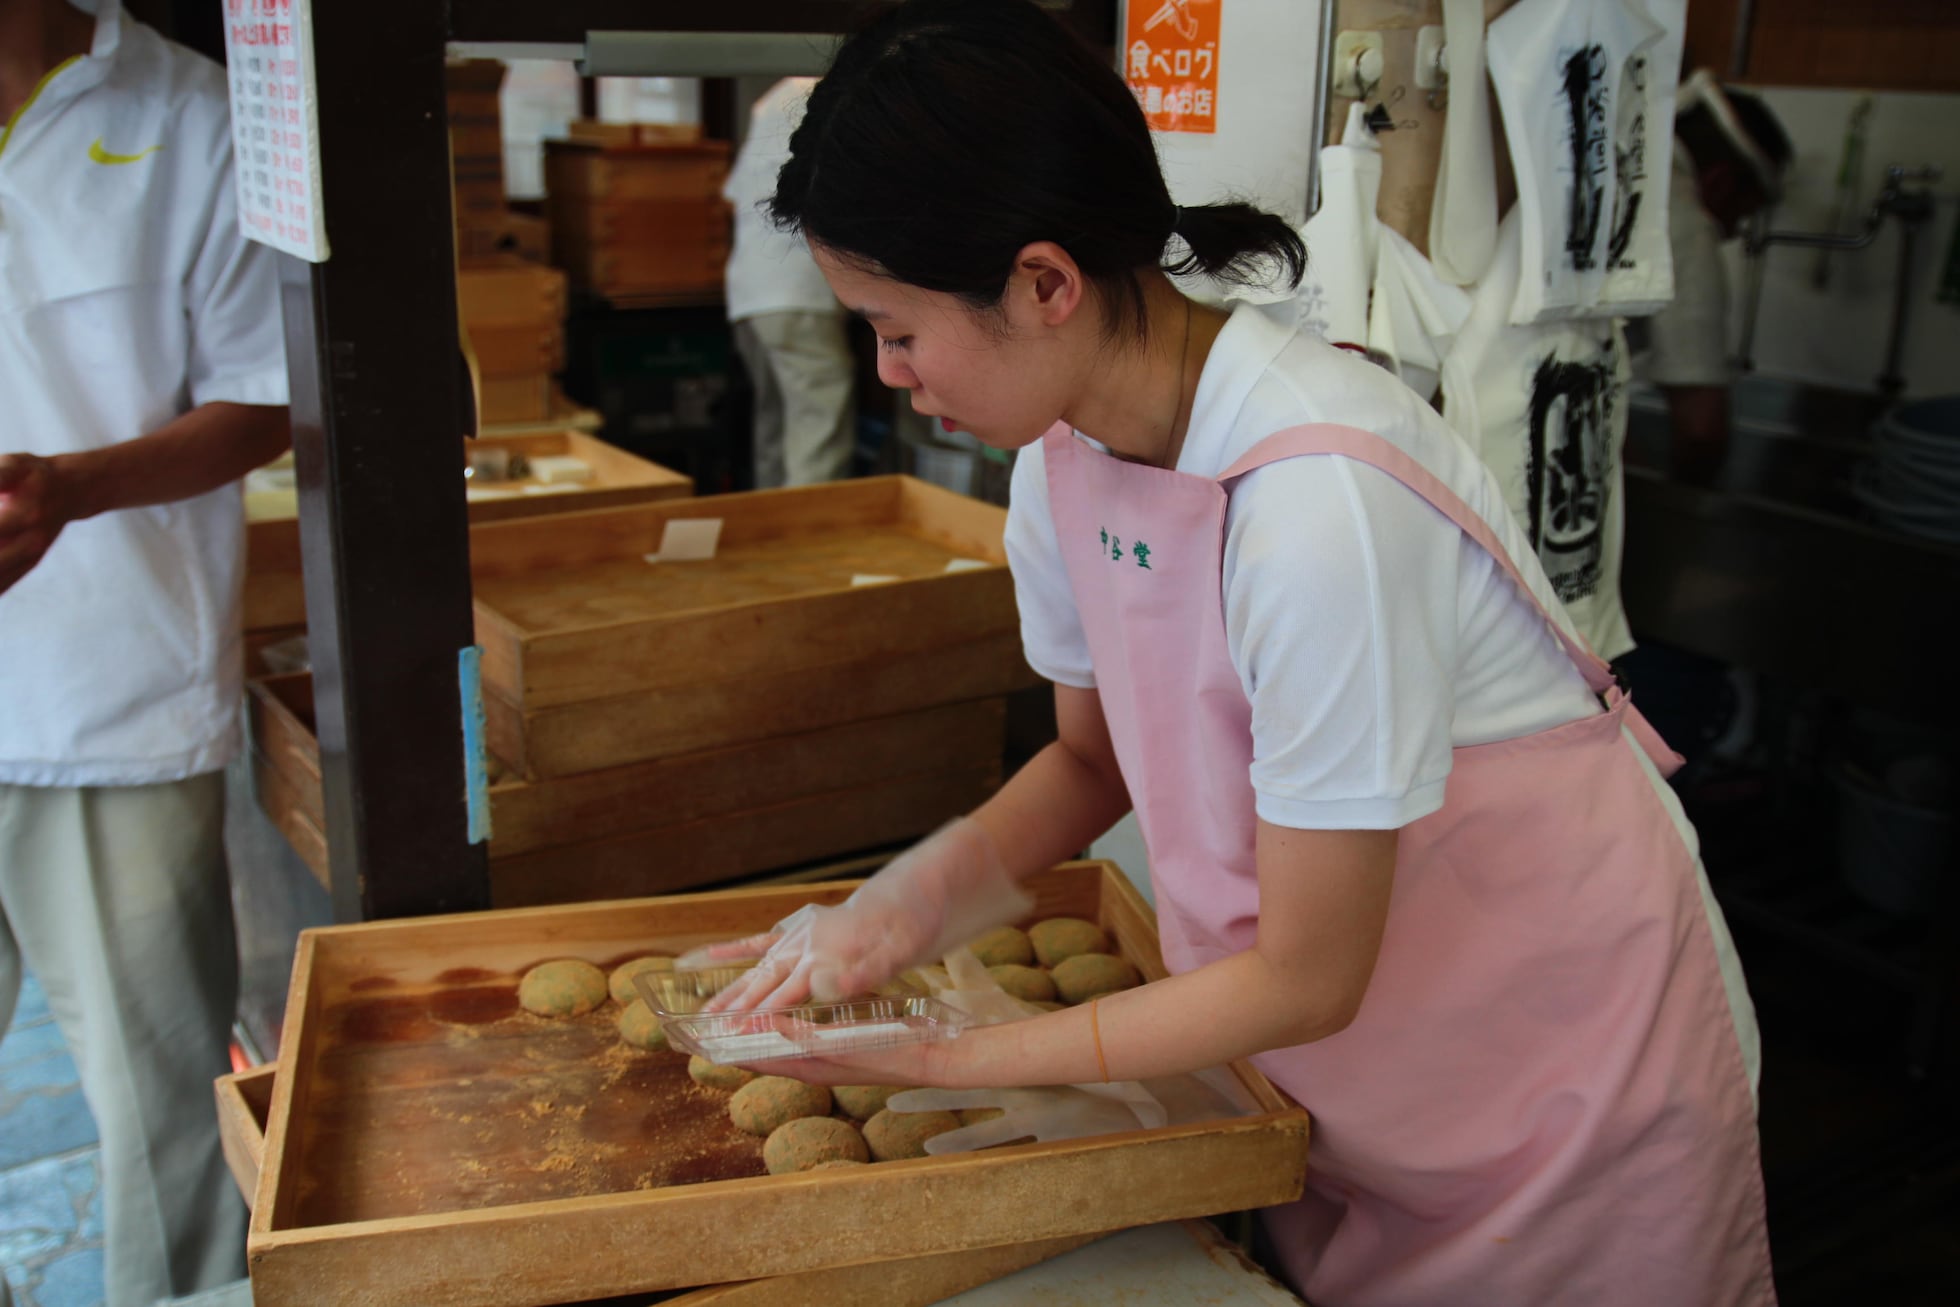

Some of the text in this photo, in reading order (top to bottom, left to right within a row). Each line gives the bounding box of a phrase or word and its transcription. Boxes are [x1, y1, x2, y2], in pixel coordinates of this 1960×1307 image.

[1129, 40, 1216, 79] 食べログ
[1100, 525, 1152, 570] 中谷堂
